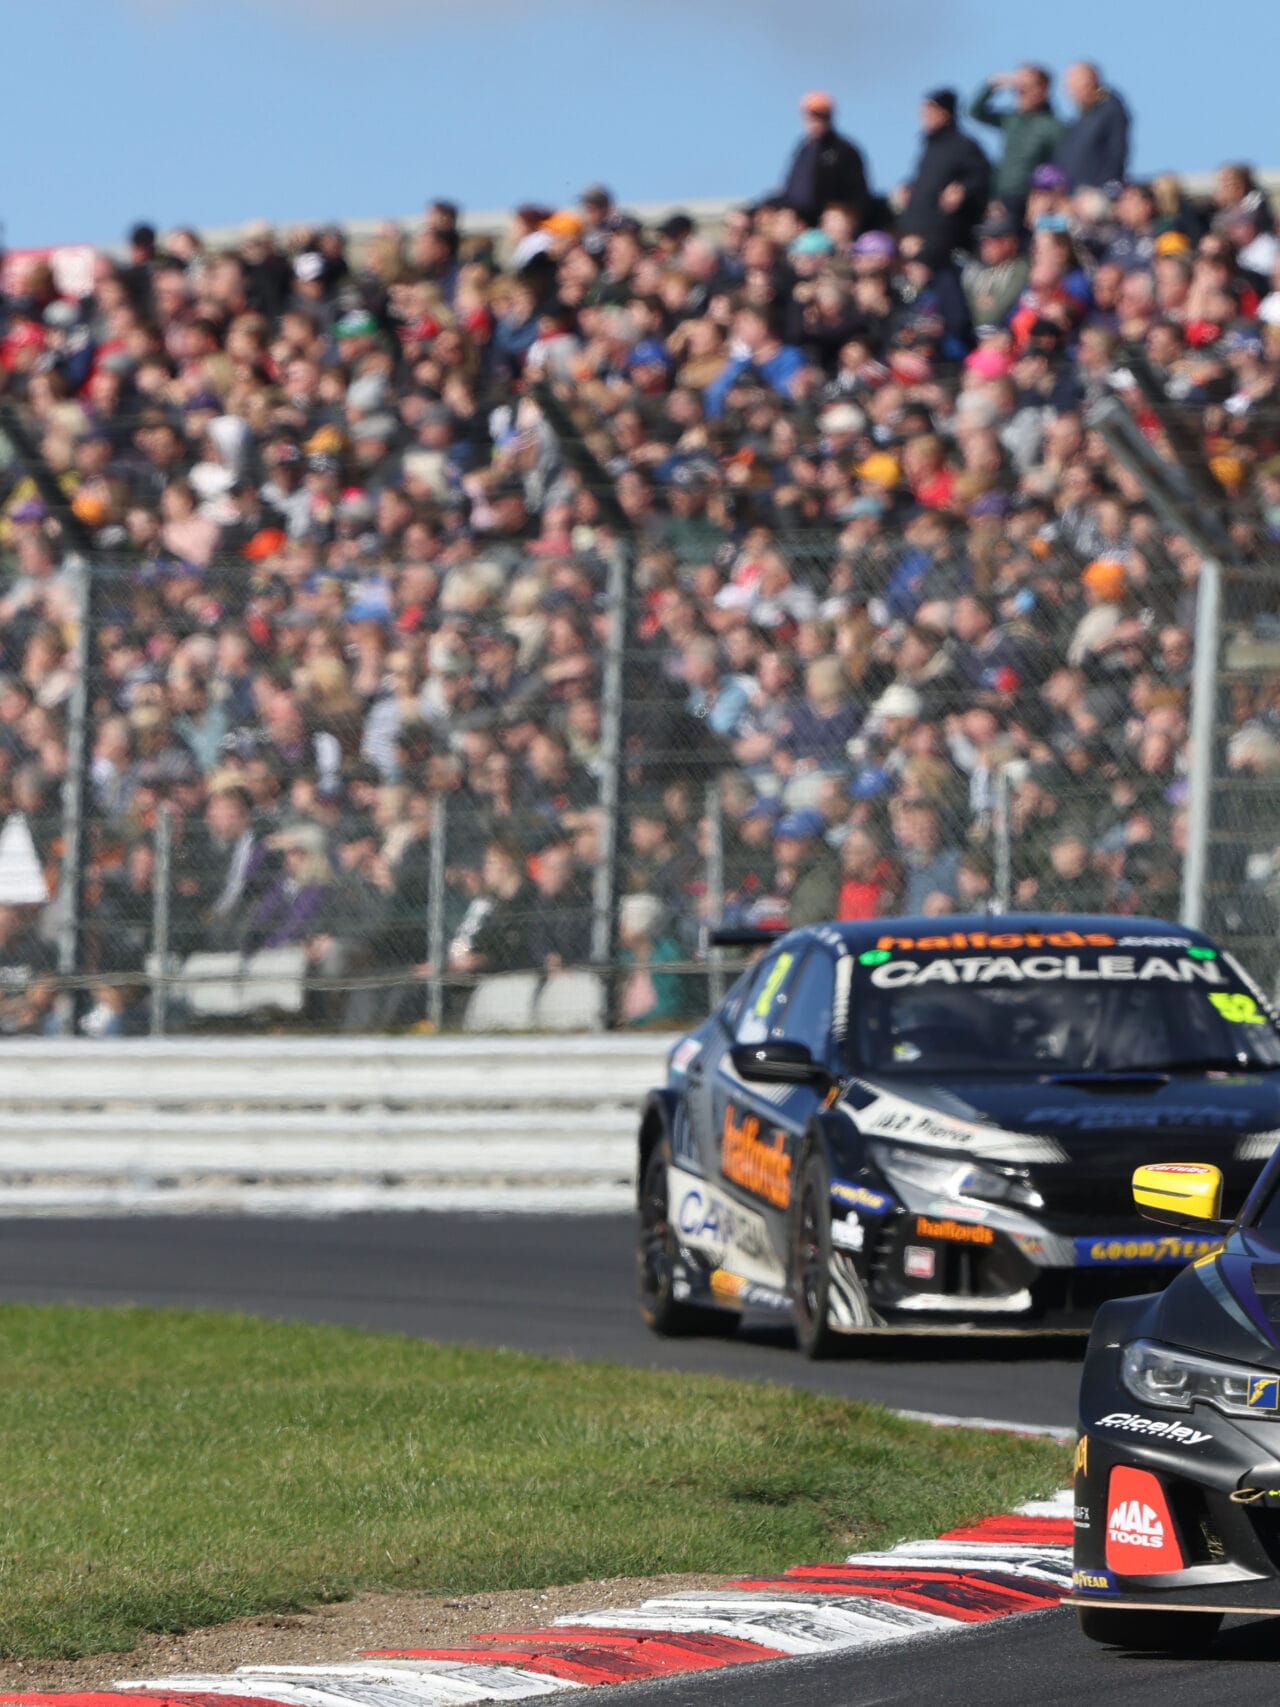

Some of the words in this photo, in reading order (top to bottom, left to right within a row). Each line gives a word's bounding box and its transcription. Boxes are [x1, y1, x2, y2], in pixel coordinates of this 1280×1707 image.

[870, 955, 1228, 989] CATACLEAN
[1207, 991, 1268, 1025] 52
[915, 1216, 994, 1244] halfords
[1101, 1413, 1214, 1444] Ciceley
[1109, 1500, 1164, 1535] MAC
[1109, 1530, 1164, 1548] TOOLS
